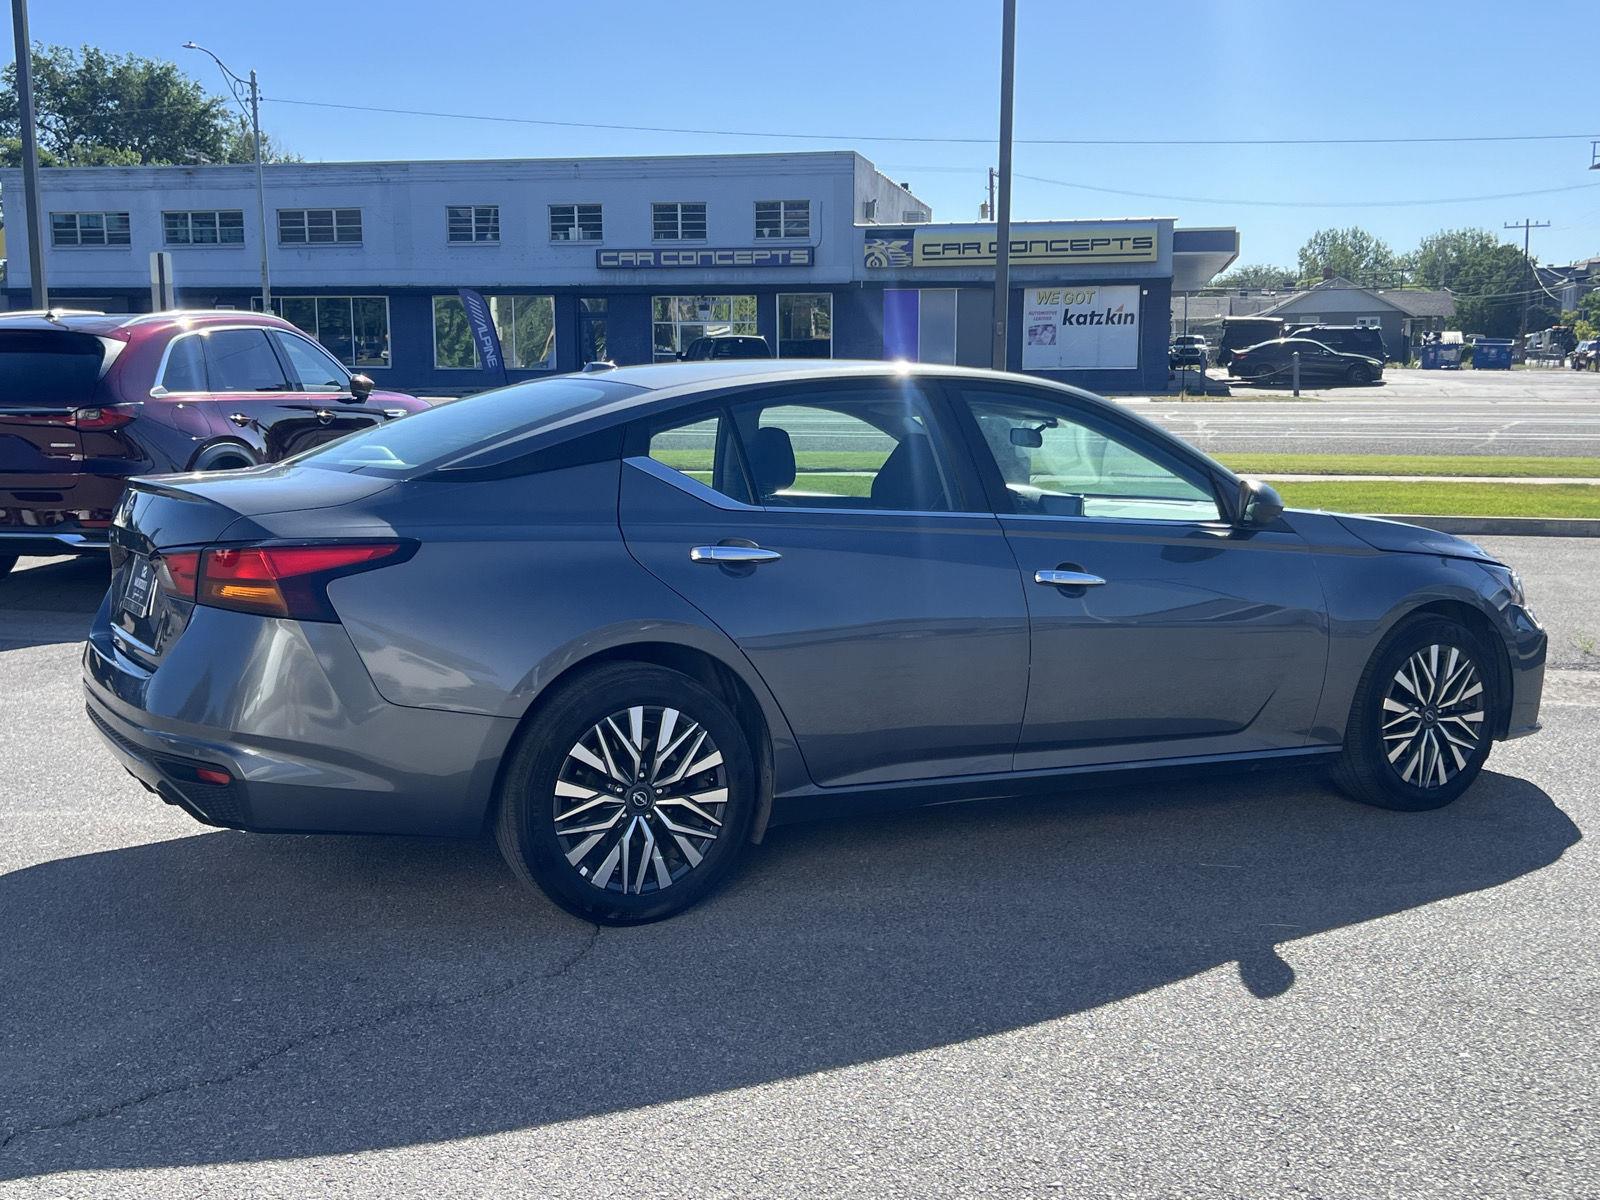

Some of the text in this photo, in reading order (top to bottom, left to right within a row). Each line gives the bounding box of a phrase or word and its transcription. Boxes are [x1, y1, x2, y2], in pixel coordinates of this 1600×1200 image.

[922, 241, 982, 256] CAR
[600, 249, 809, 266] CAR CONCEPTS
[1036, 290, 1096, 305] WE GOT
[1062, 304, 1135, 326] katzkin
[475, 319, 498, 369] ALPINE
